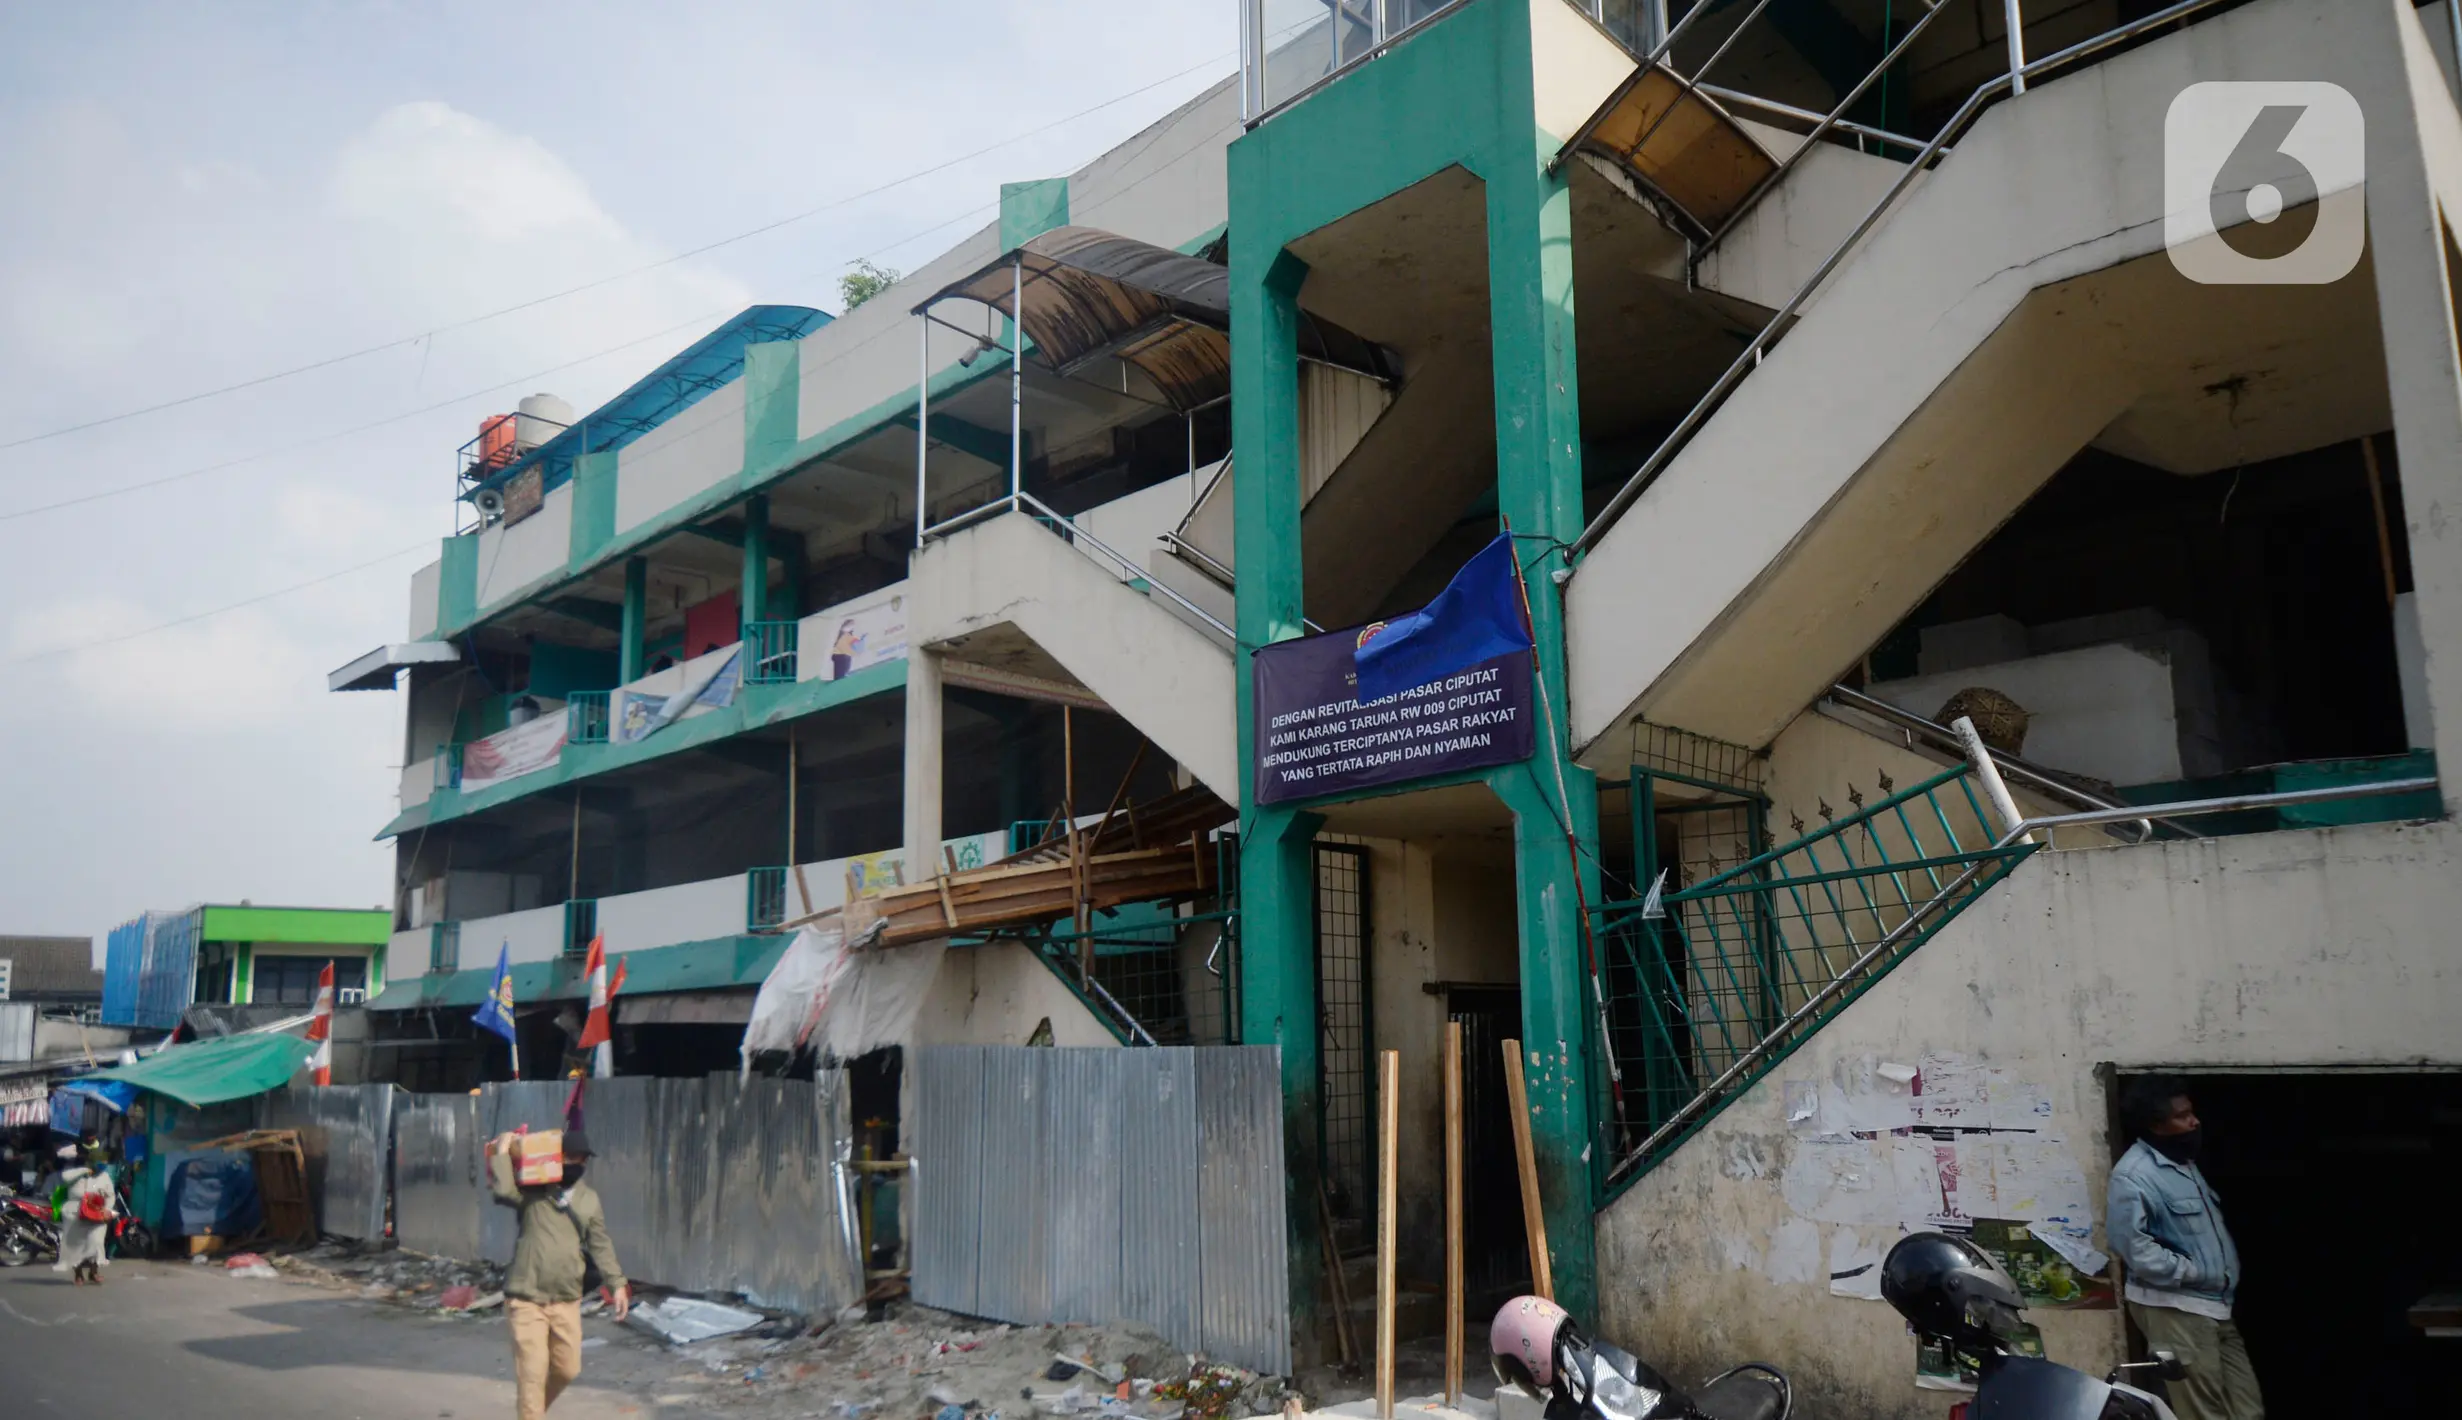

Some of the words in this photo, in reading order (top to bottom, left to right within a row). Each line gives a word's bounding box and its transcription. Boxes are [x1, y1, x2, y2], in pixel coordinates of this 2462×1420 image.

[1270, 731, 1296, 748] KAMI
[1298, 721, 1347, 741] KARANG
[1350, 710, 1398, 730] TARUNA
[1400, 705, 1421, 721] RW
[1424, 701, 1445, 716] 009
[1448, 688, 1502, 711] CIPUTAT
[1272, 707, 1315, 729] DENGAN
[1400, 681, 1443, 701] PASAR
[1446, 668, 1499, 691] CIPUTAT
[1263, 743, 1331, 768] MENDUKUNG
[1333, 726, 1413, 753] TERCIPTANYA
[1416, 718, 1459, 738] PASAR
[1462, 707, 1516, 729] RAKYAT
[1281, 766, 1314, 782] YANG
[1316, 757, 1364, 777] TERTATA
[1366, 749, 1402, 767] RAPIH
[1405, 744, 1431, 760] DAN
[1434, 733, 1491, 755] NYAMAN
